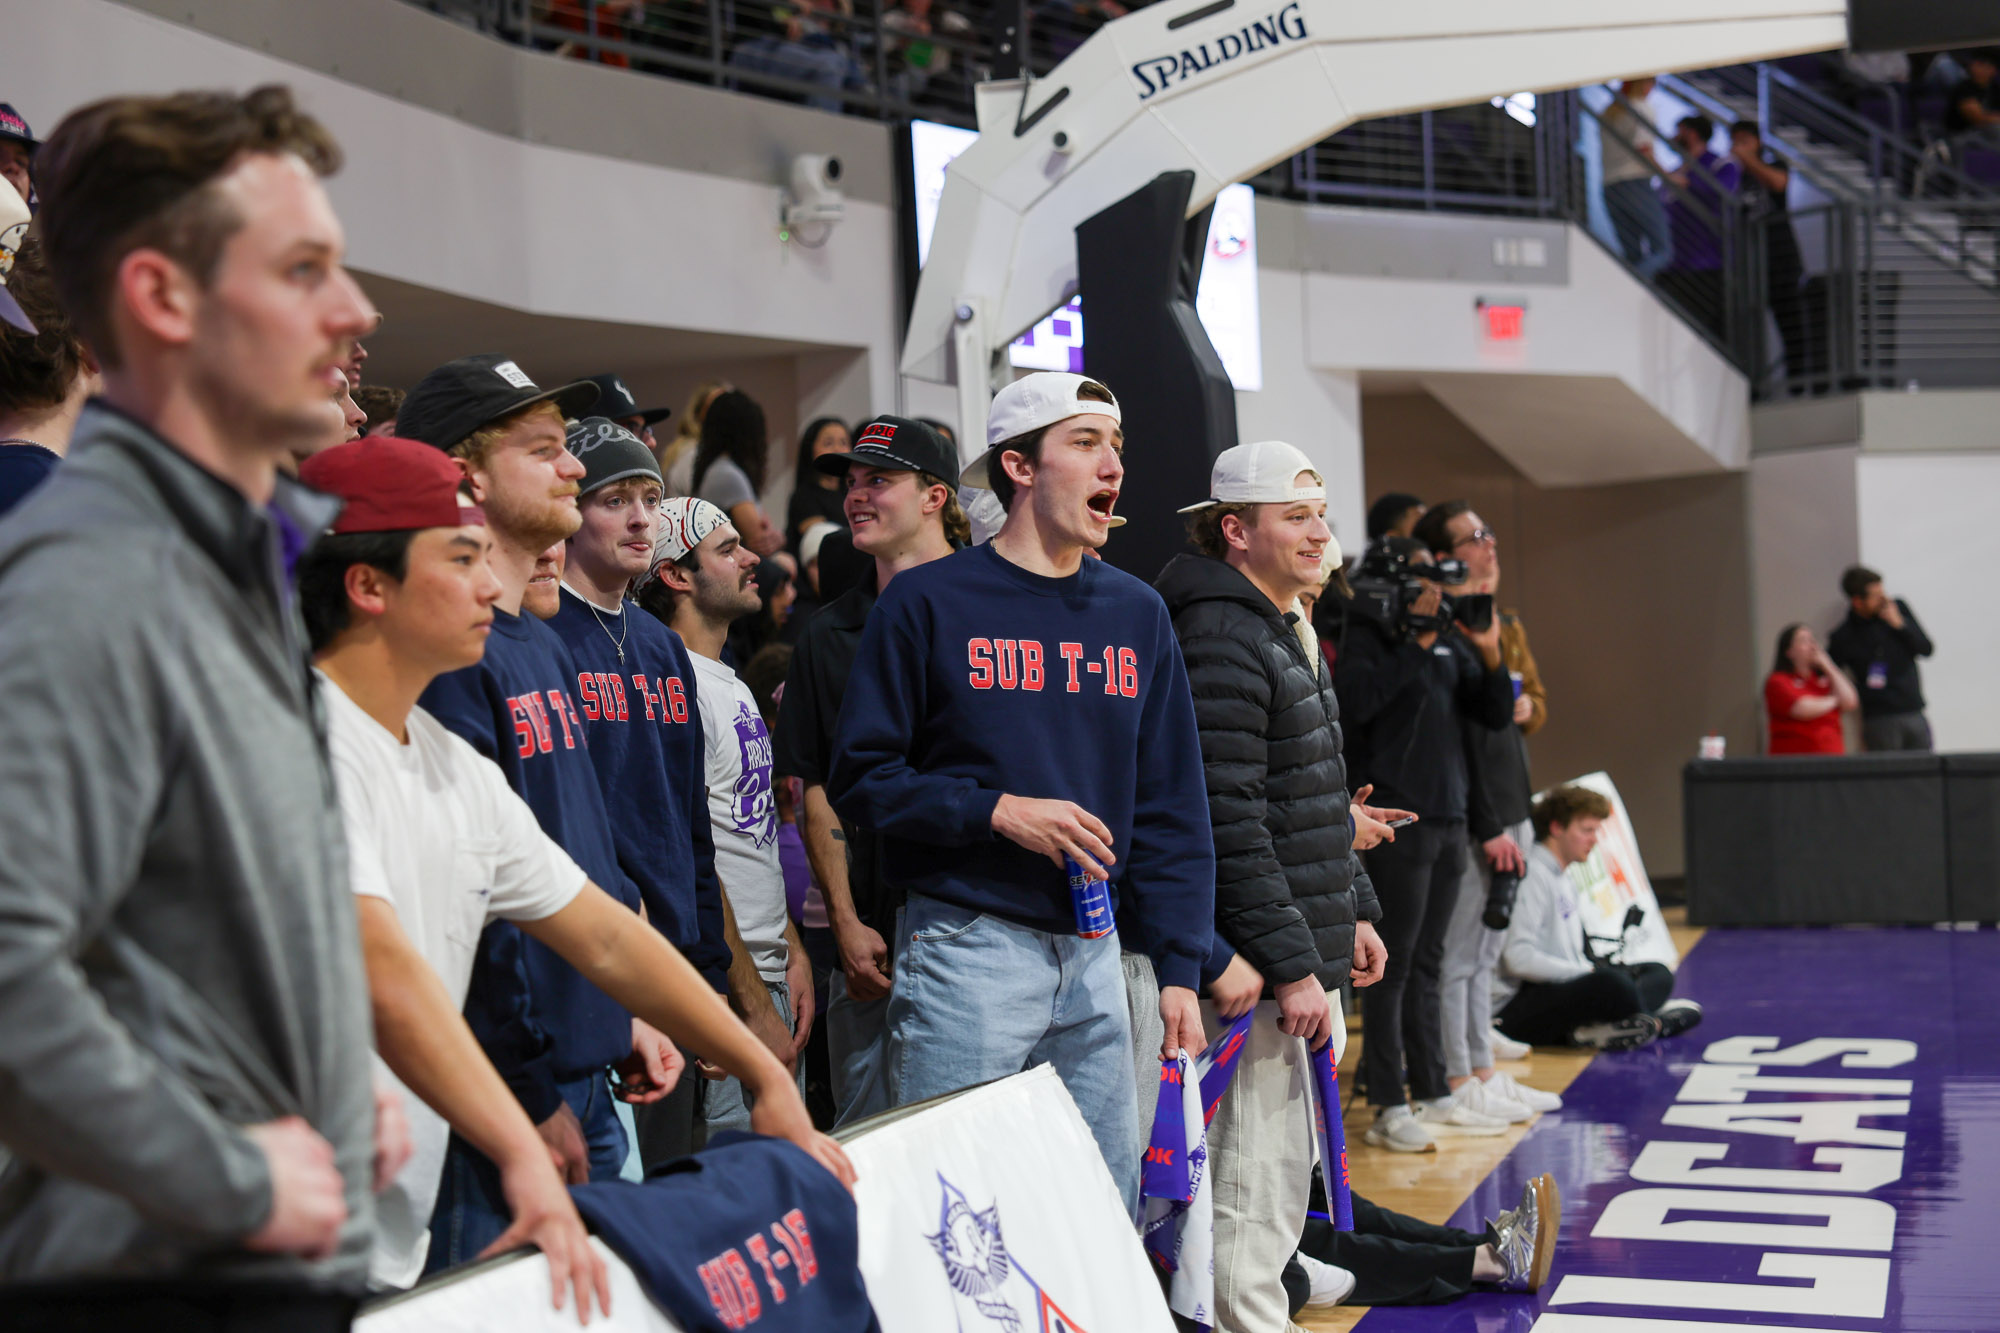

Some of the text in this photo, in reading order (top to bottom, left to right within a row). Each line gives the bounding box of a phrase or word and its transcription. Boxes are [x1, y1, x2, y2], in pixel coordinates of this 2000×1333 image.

[1133, 2, 1308, 100] SPALDING
[577, 671, 689, 725] SUB T-16
[968, 636, 1140, 699] SUB T-16
[547, 689, 587, 751] T-
[696, 1207, 819, 1331] SUB T-16
